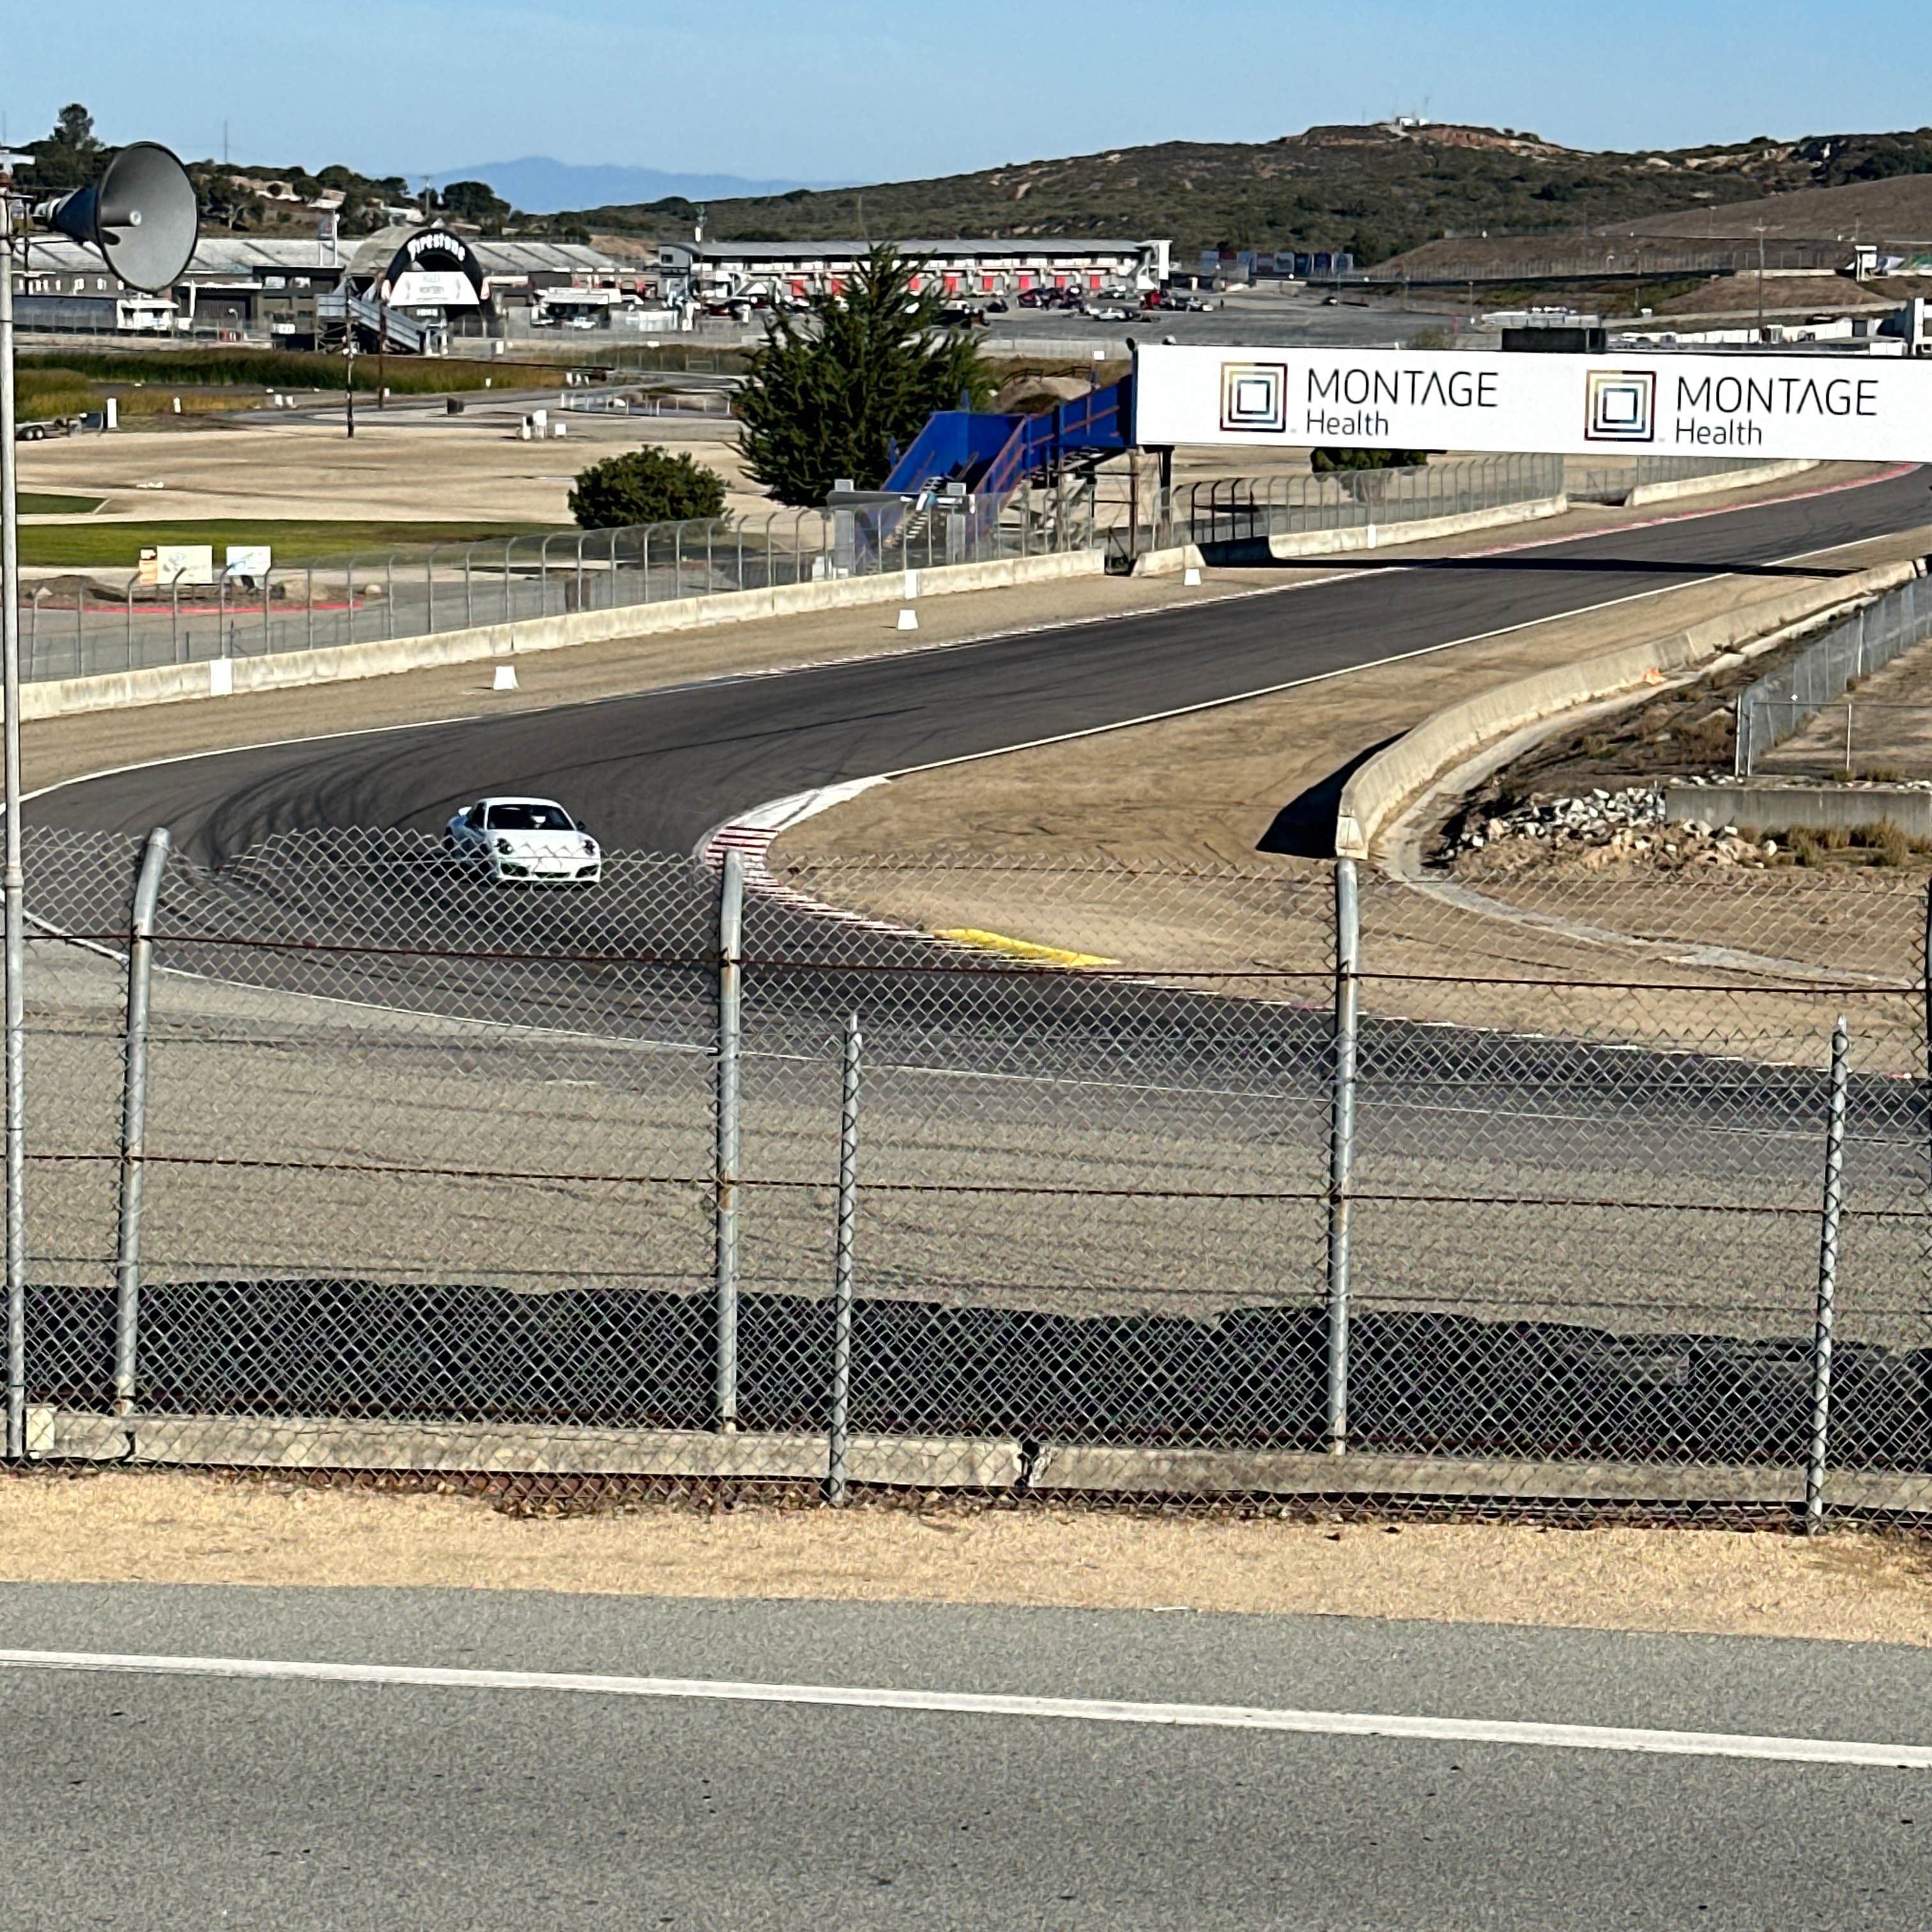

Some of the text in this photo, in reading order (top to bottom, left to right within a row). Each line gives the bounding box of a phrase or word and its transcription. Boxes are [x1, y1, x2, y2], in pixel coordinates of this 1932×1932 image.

[1308, 367, 1499, 408] MONTAGE
[1676, 375, 1880, 416] MONTAGE
[1307, 409, 1389, 436] Health
[1675, 417, 1762, 445] Health
